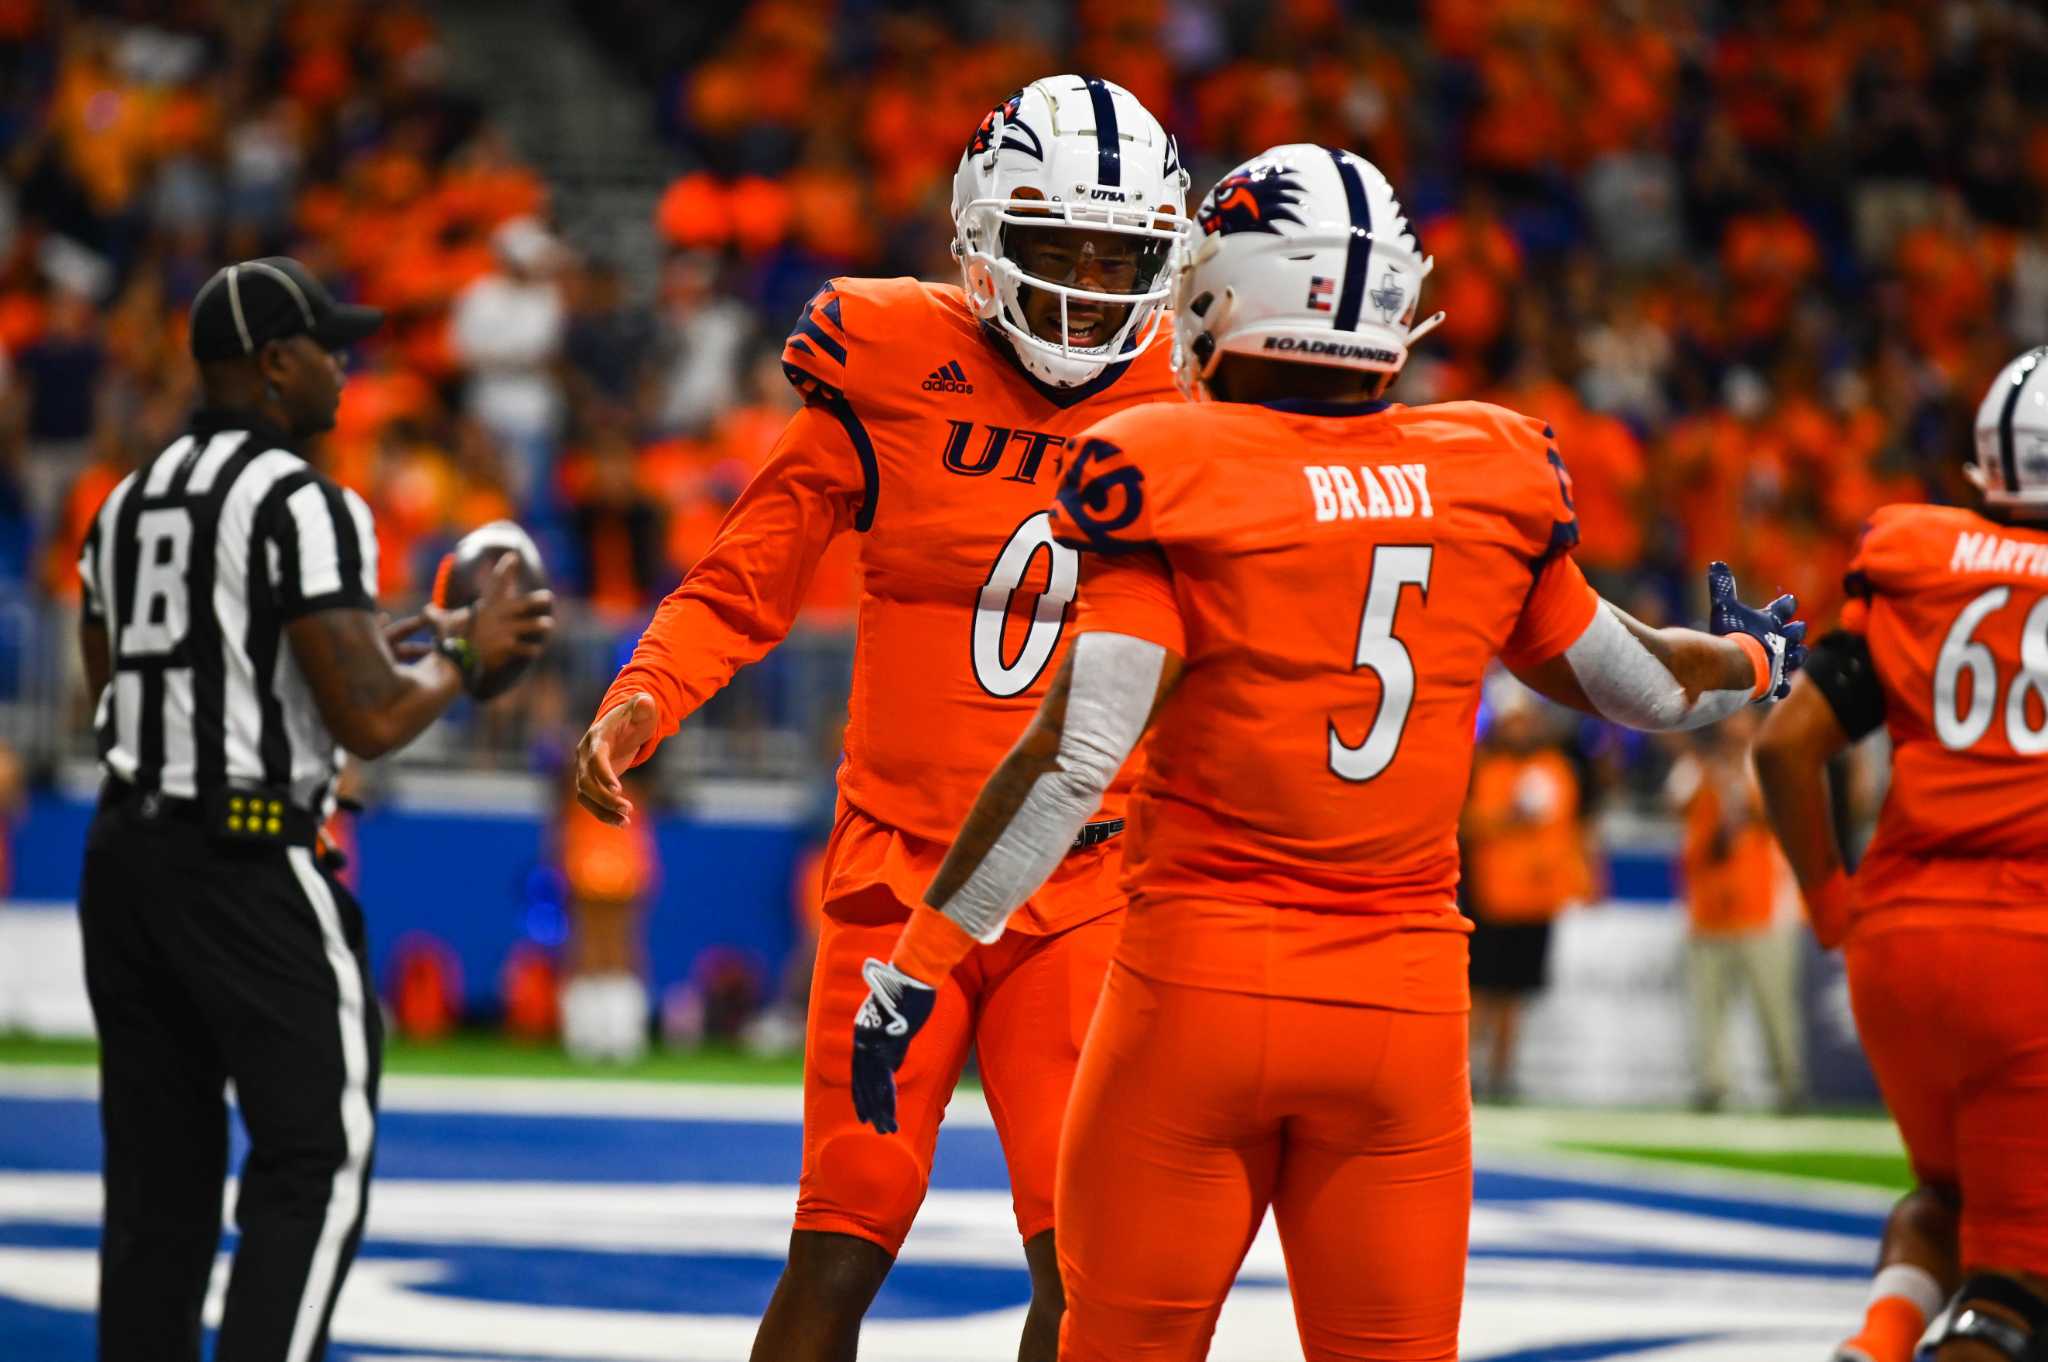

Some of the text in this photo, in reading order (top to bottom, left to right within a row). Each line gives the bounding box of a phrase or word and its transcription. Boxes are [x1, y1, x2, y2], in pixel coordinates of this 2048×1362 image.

[1090, 189, 1126, 203] UTSA
[1262, 336, 1400, 365] ROADRUNNERS
[921, 378, 974, 395] adidas
[942, 419, 1064, 486] UT
[1304, 463, 1435, 522] BRADY
[119, 506, 195, 656] B
[969, 509, 1082, 699] 0
[1327, 543, 1435, 784] 5
[1933, 584, 2048, 757] 68
